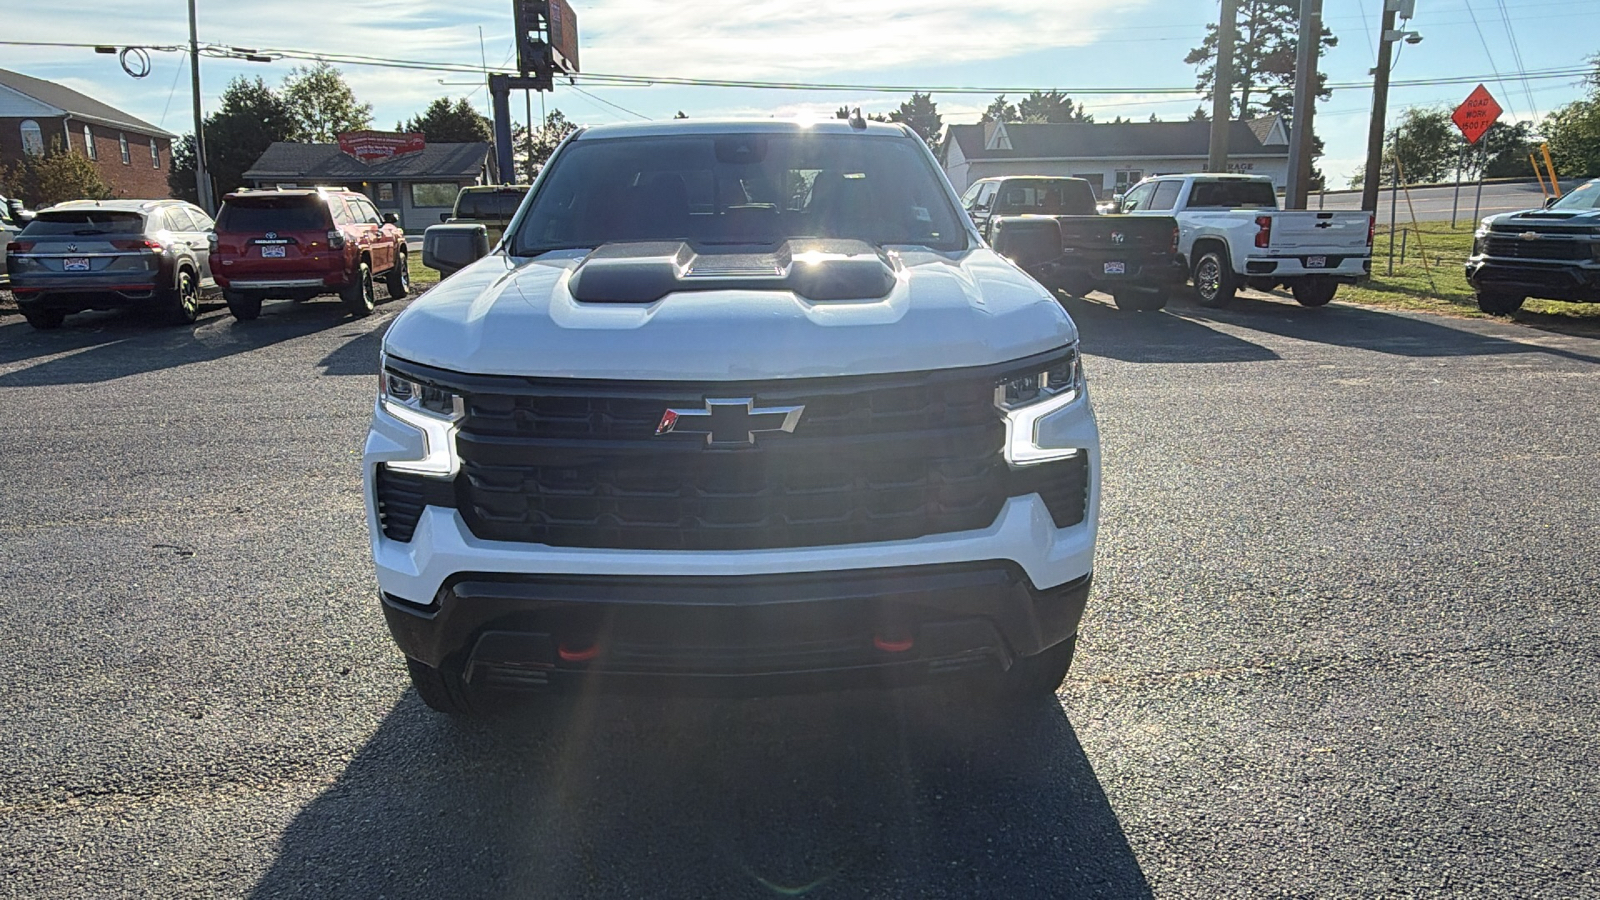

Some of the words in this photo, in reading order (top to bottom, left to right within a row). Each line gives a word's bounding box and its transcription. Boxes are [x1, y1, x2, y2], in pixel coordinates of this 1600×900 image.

[1467, 98, 1489, 107] ROAD
[1466, 110, 1487, 118] WORK
[1462, 121, 1479, 130] 1500
[1481, 120, 1489, 129] FT
